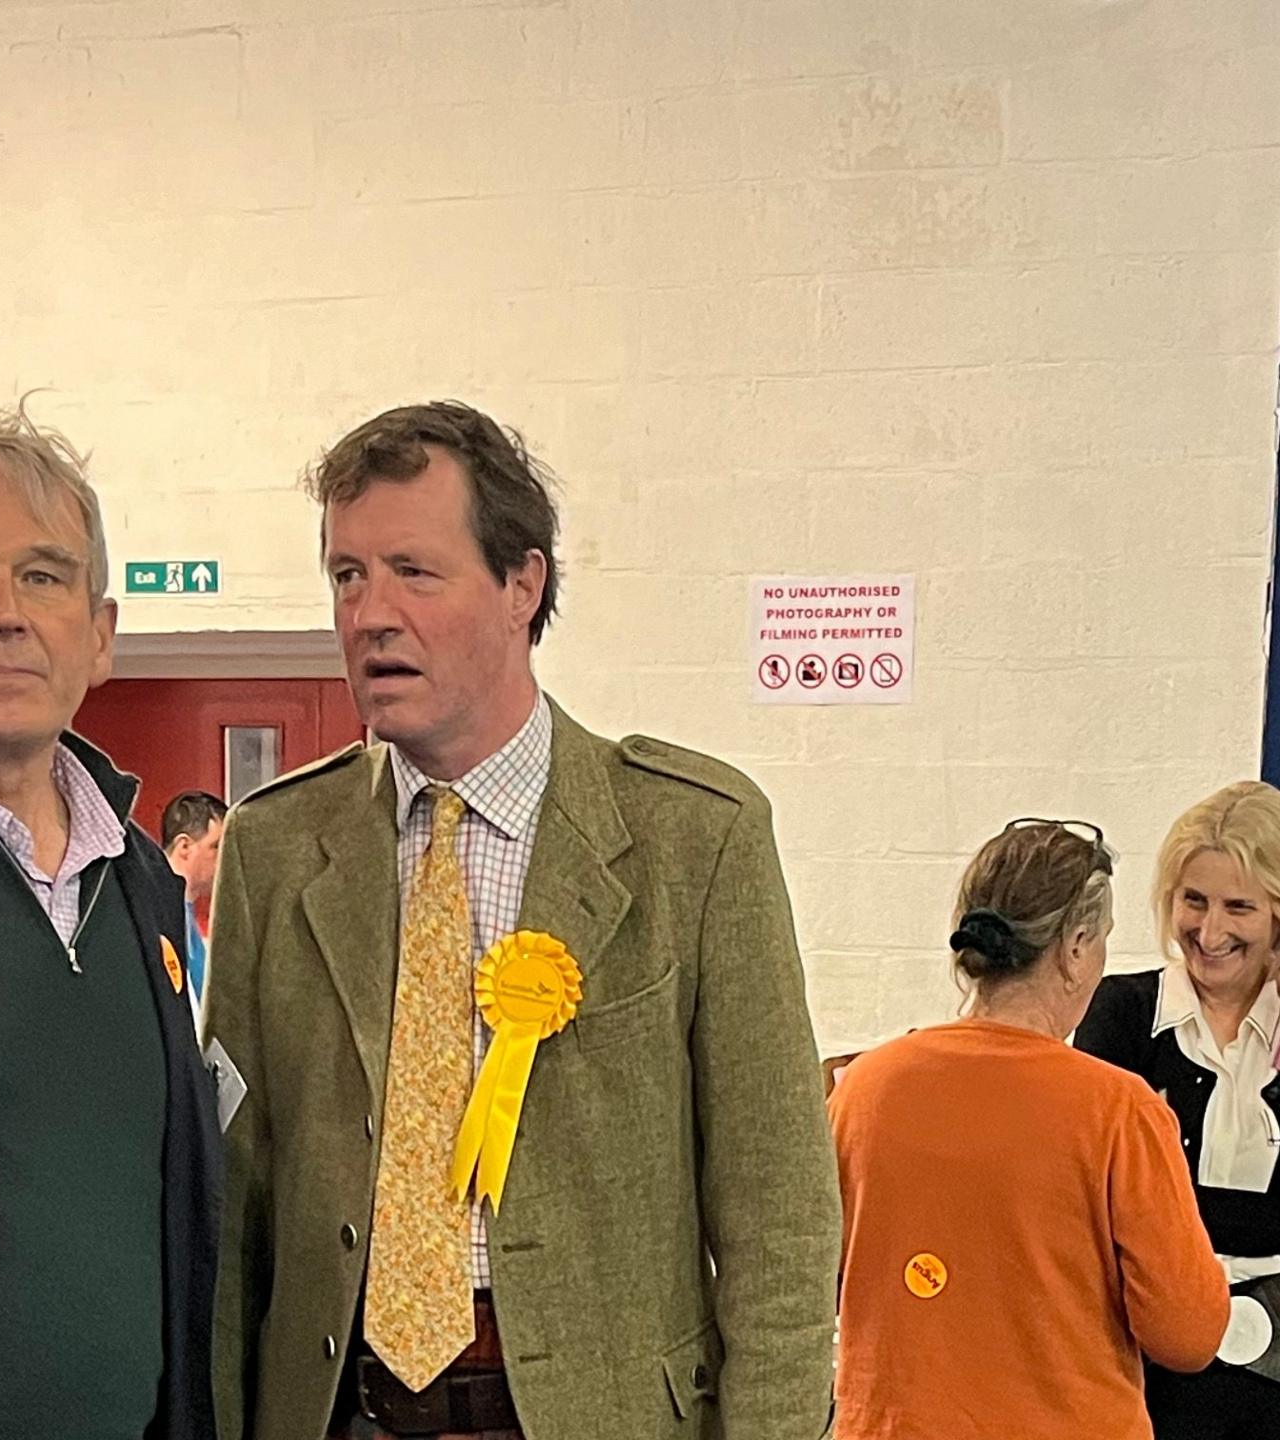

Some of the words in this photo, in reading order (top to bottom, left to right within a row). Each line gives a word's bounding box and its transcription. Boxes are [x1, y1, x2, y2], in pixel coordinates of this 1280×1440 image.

[763, 588, 784, 599] NO
[788, 586, 901, 599] UNAUTHORISED
[766, 607, 872, 619] PHOTOGRAPHY
[877, 607, 897, 618] OR
[760, 629, 817, 640] FILMING
[822, 628, 903, 639] PERMITTED
